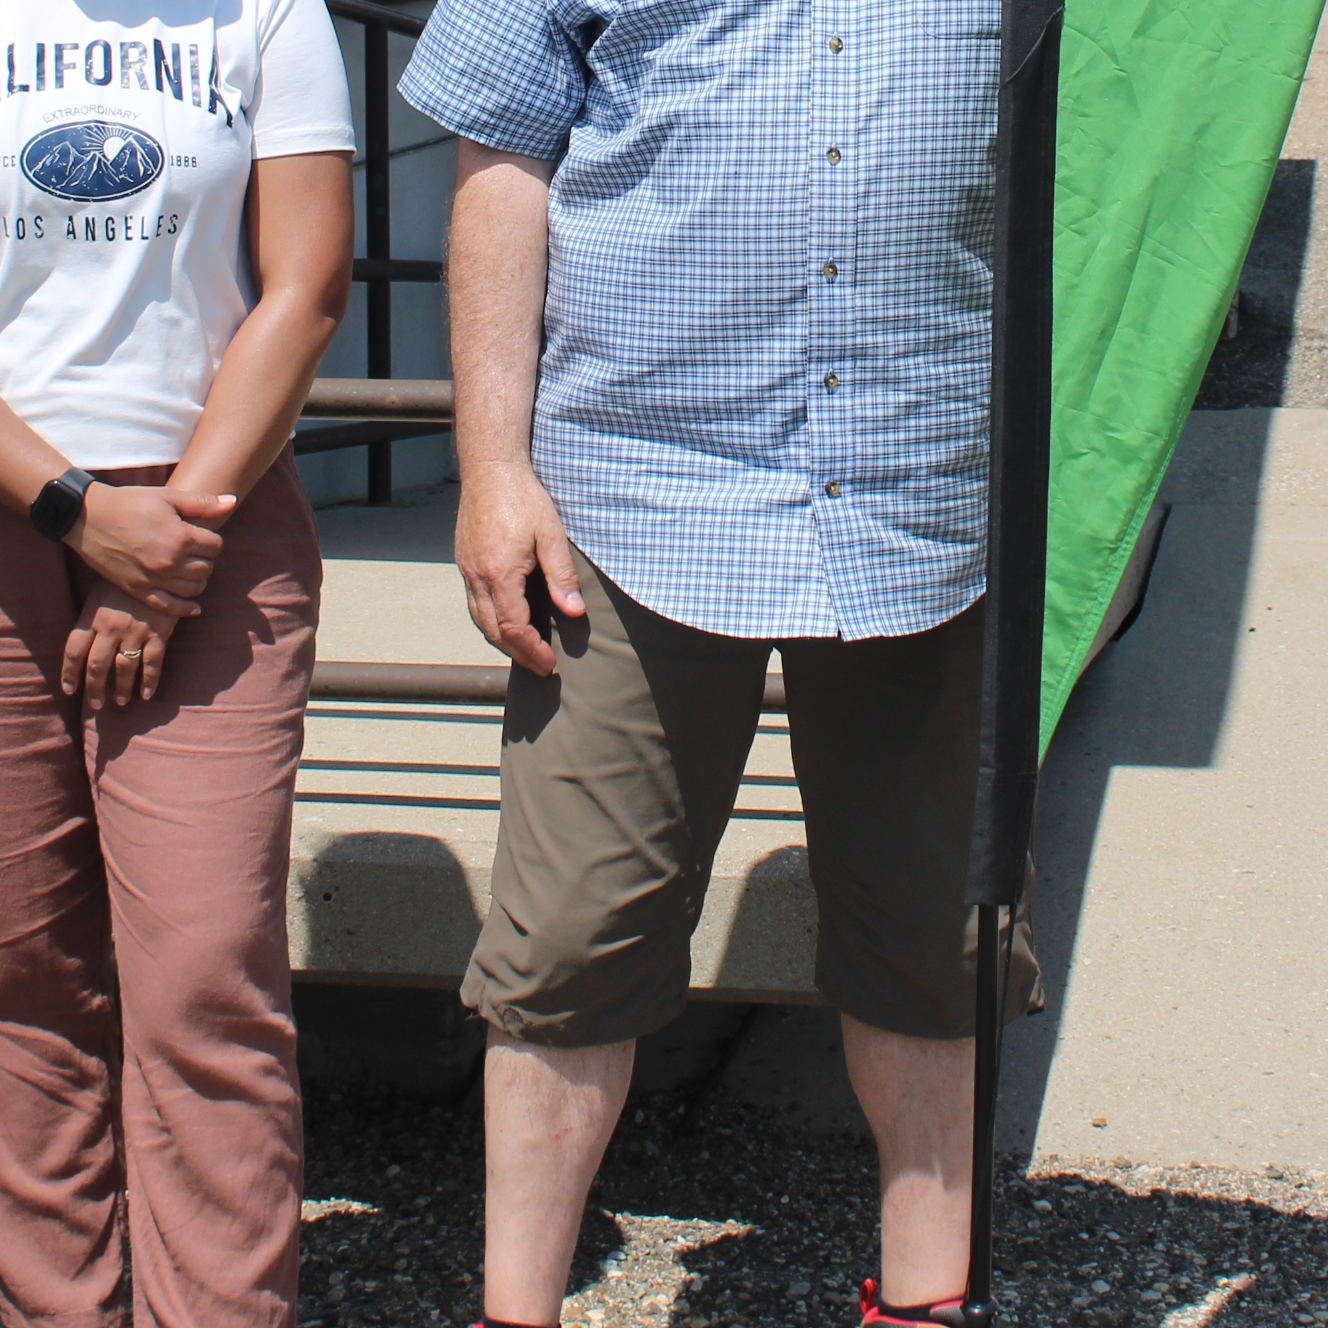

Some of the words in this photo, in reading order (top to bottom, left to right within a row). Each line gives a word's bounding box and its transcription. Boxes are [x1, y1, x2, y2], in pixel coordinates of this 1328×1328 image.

[42, 104, 141, 124] EXTRAORDINARY
[3, 215, 45, 240] LOS
[66, 213, 180, 242] ANGELES
